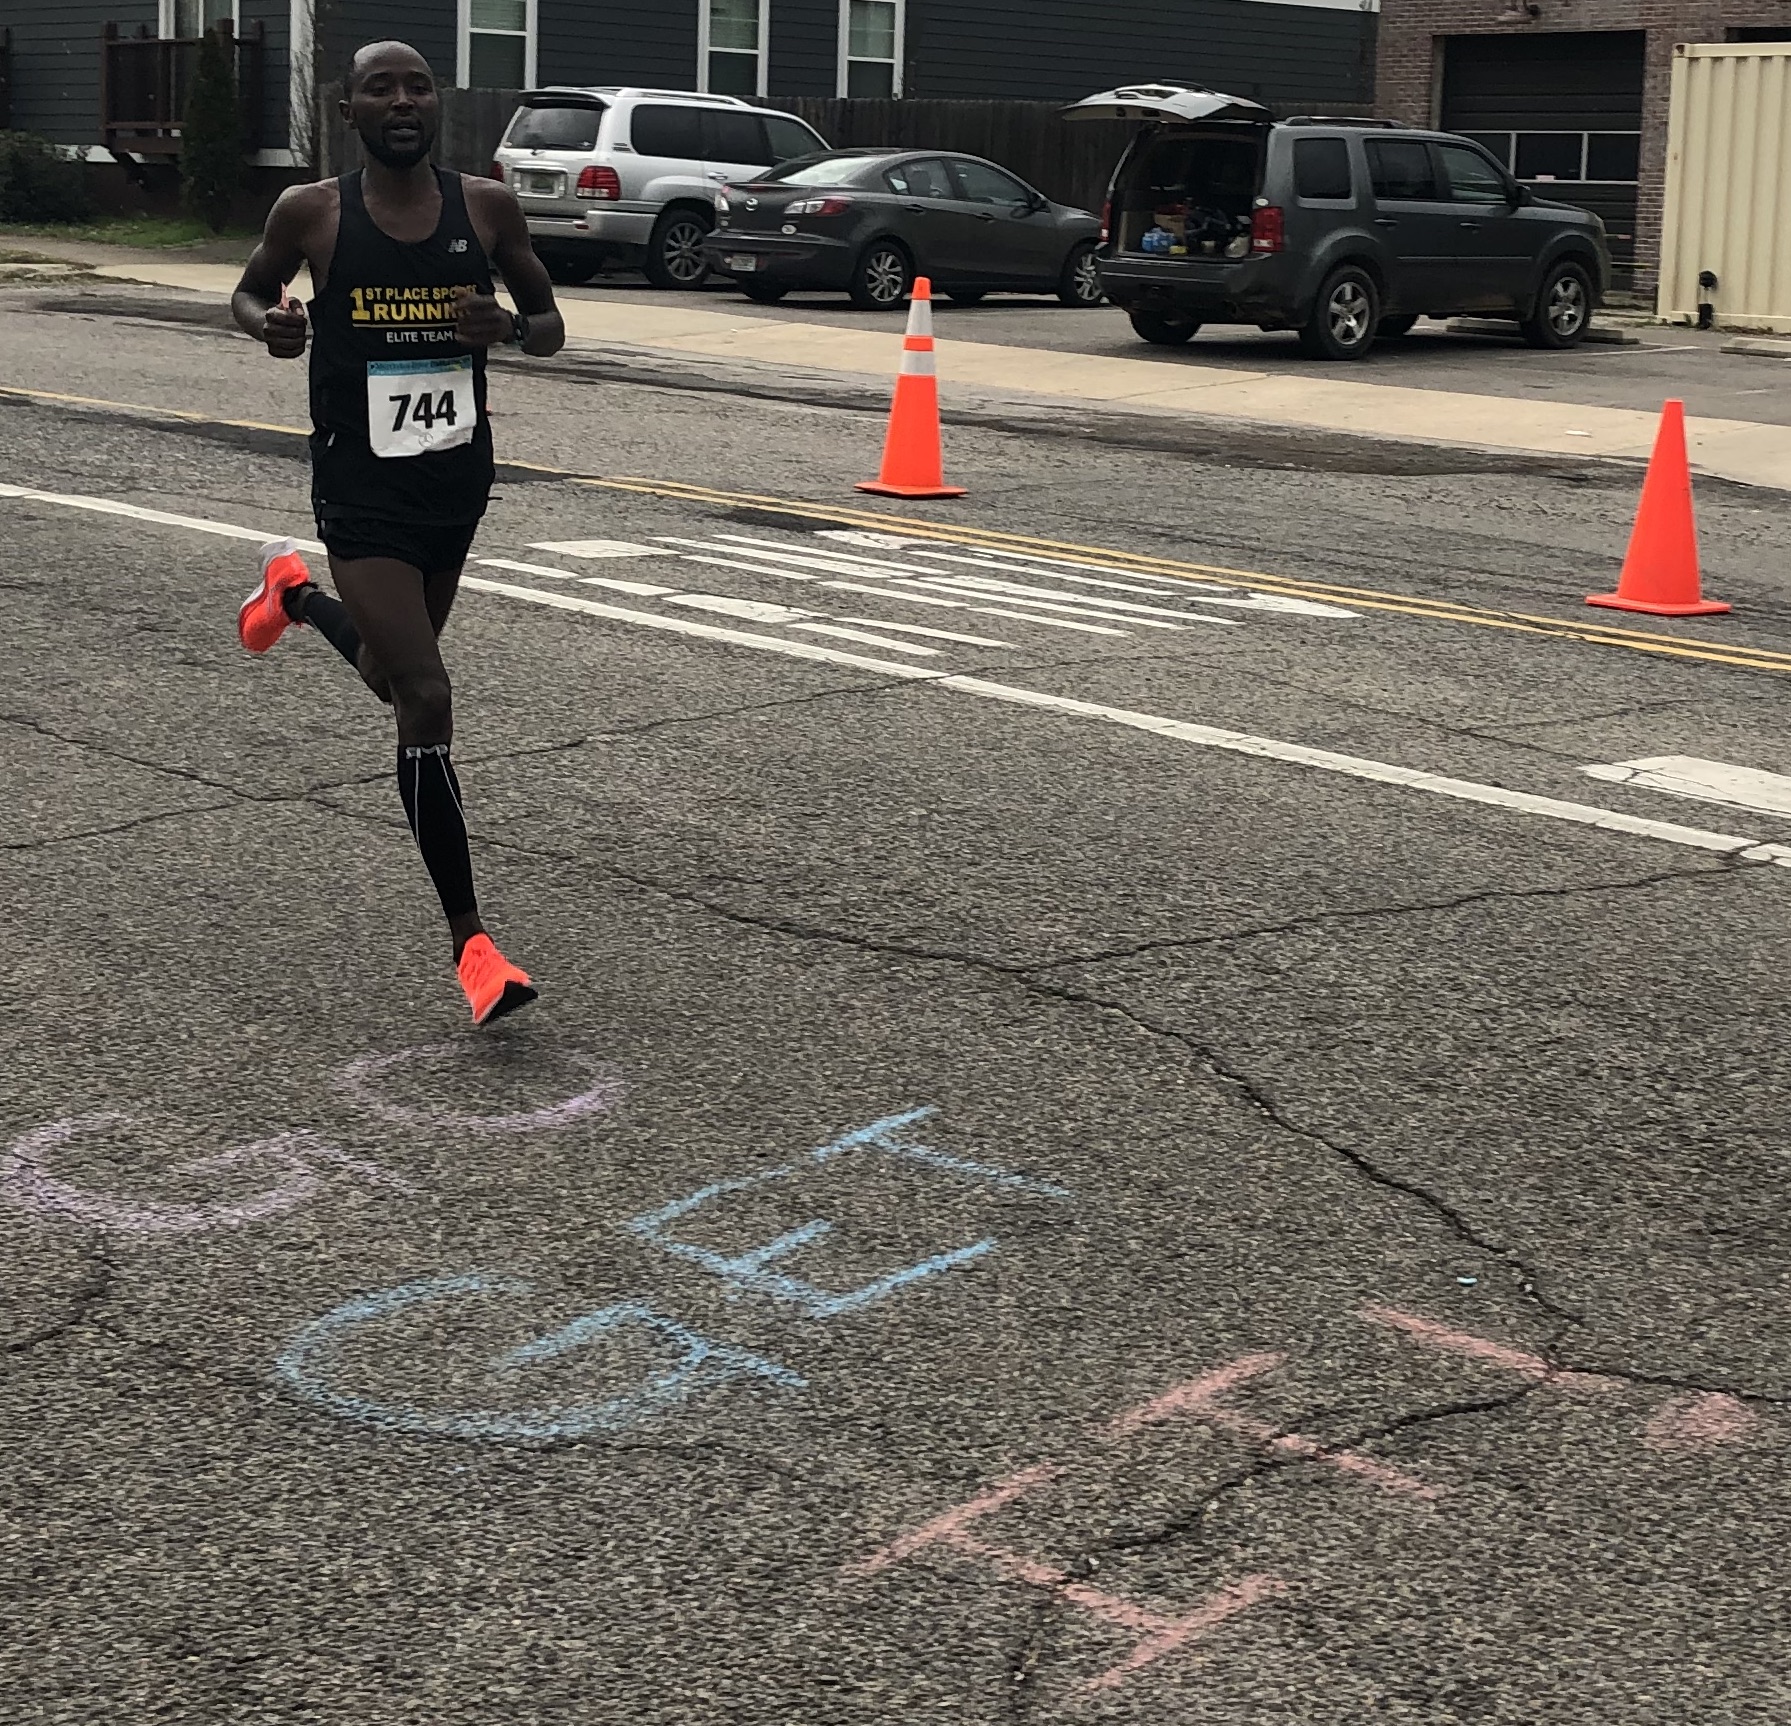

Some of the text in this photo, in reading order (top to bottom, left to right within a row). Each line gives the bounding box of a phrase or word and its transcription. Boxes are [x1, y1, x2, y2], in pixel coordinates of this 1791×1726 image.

[385, 287, 430, 301] PLACE
[432, 284, 477, 301] SPO
[373, 302, 460, 321] RUNNI
[386, 330, 454, 343] ELITE TEAM
[389, 390, 457, 432] 744
[0, 1042, 630, 1233] GO
[277, 1105, 1074, 1442] GET
